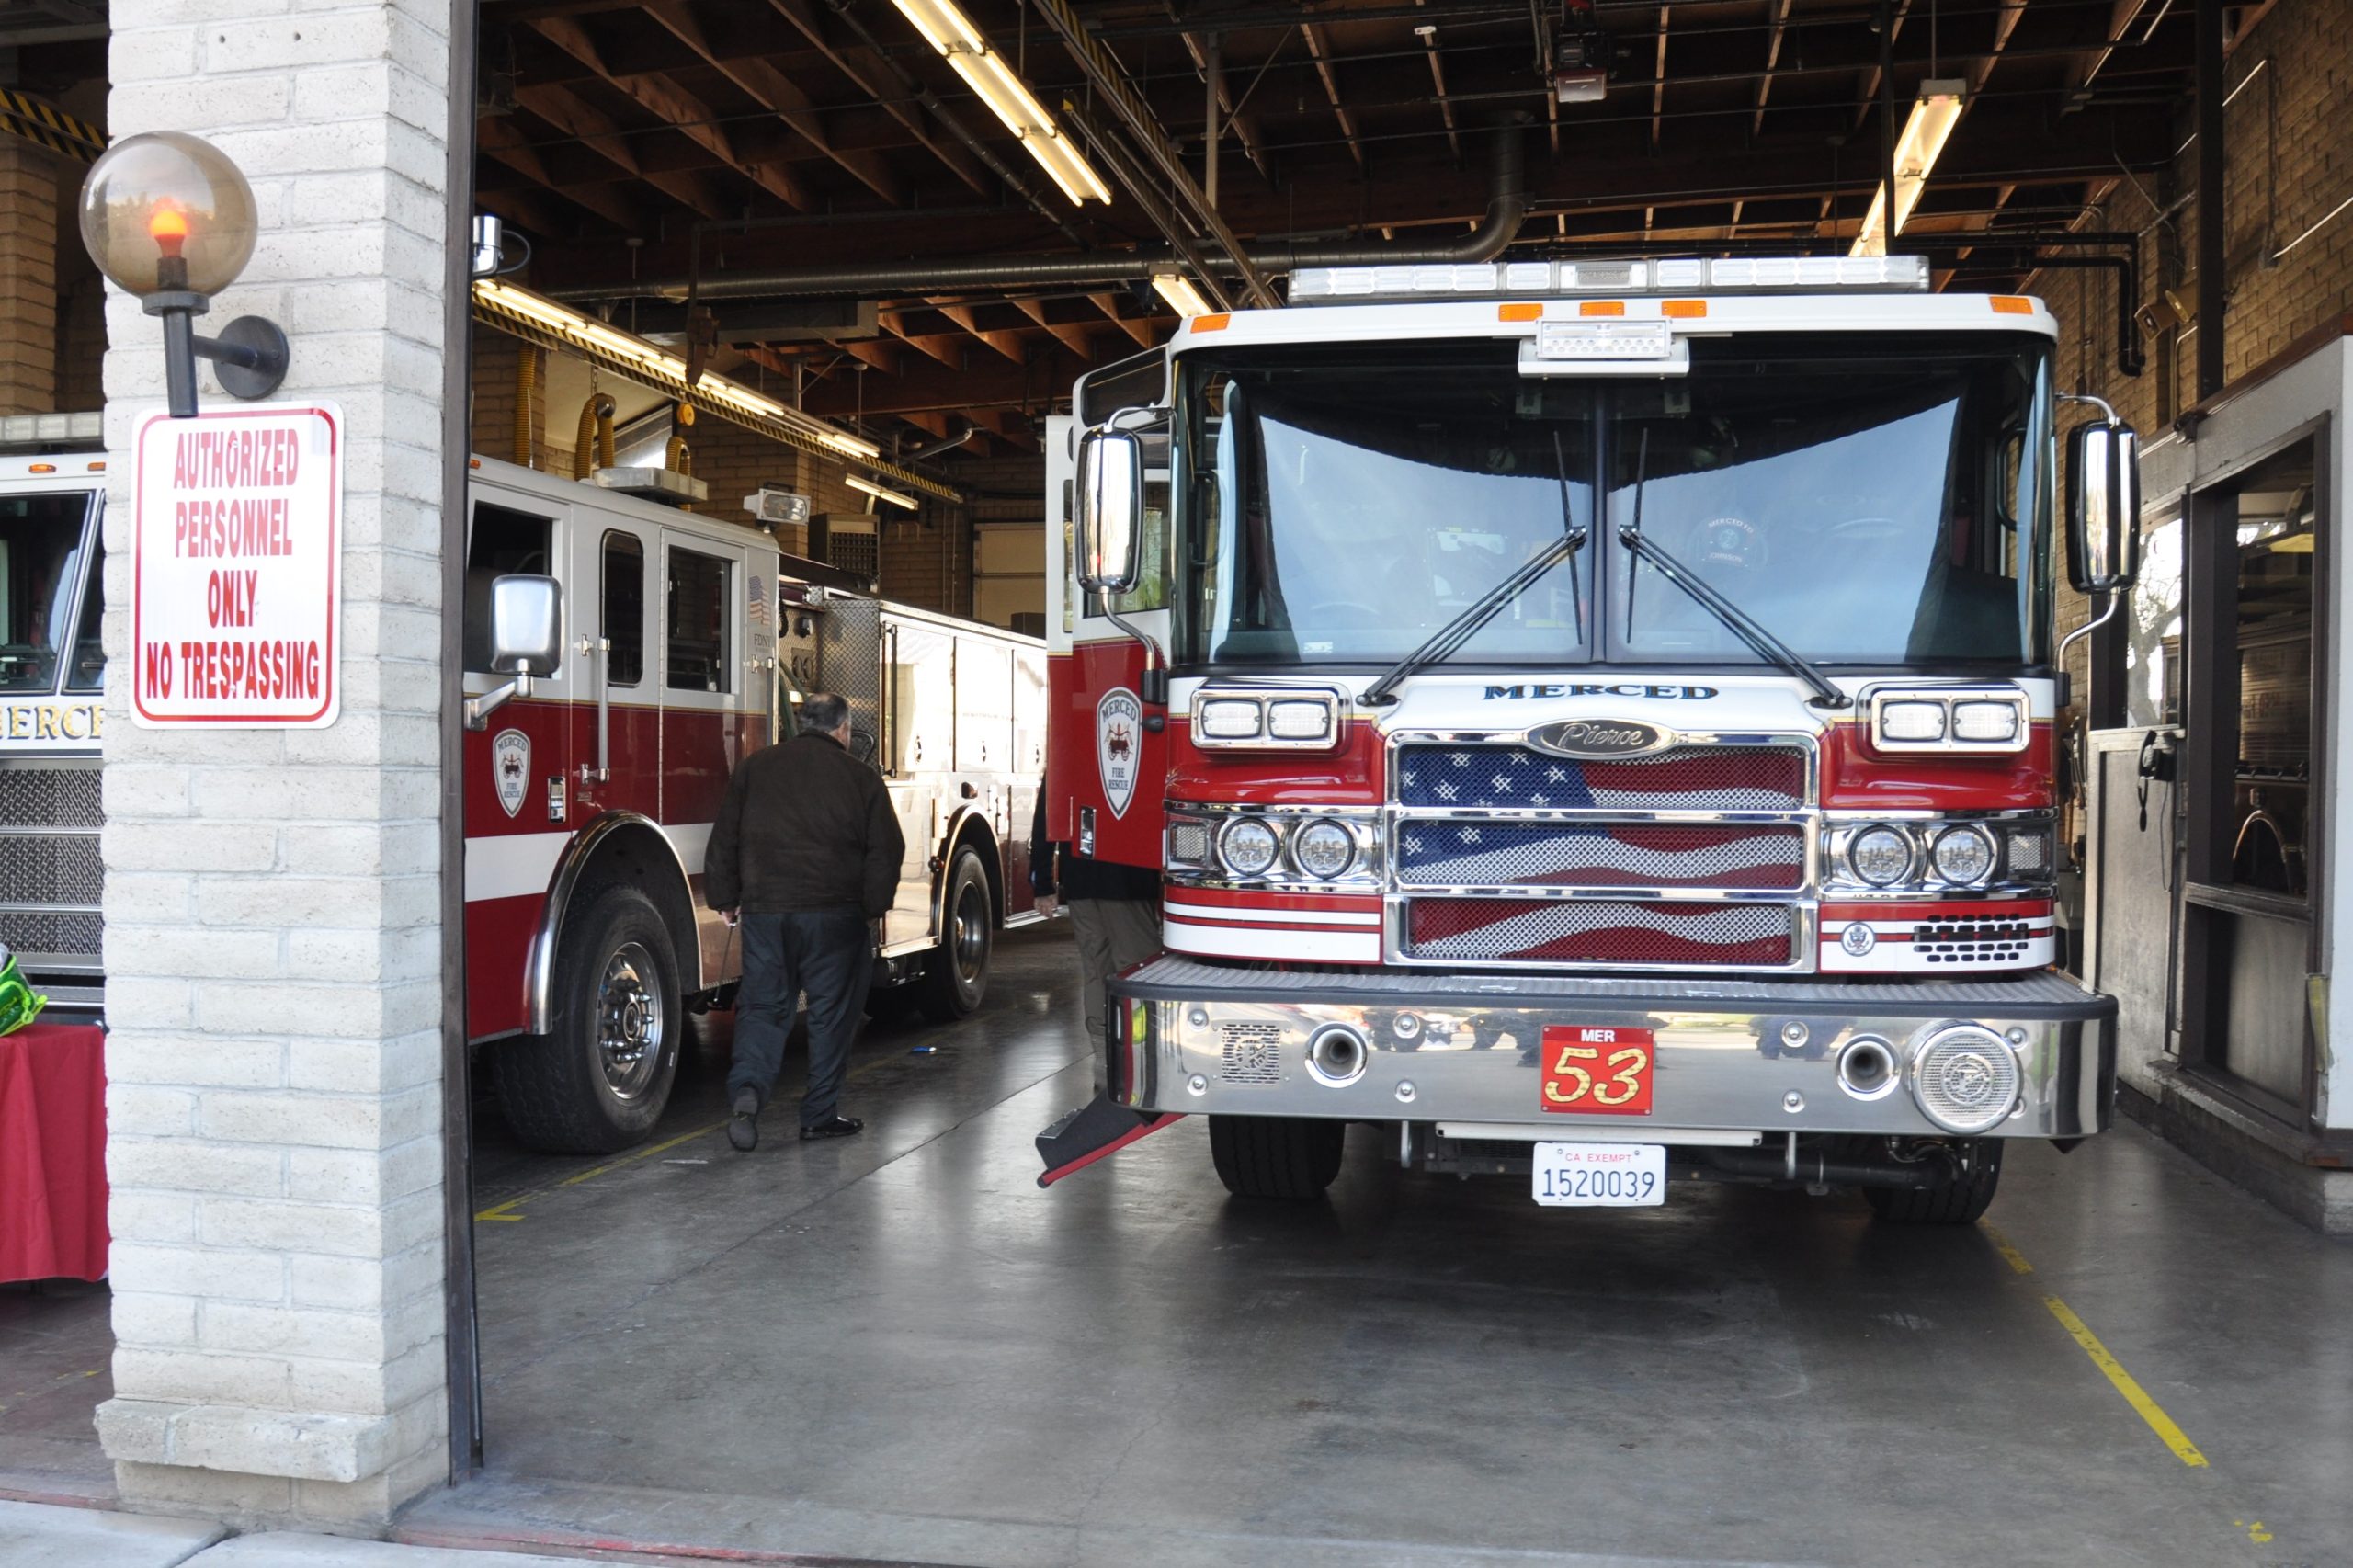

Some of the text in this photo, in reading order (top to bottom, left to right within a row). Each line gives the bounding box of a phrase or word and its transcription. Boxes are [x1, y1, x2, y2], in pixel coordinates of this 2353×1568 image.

[174, 428, 300, 490] AUTHORIZED
[175, 498, 293, 558] PERSONNEL
[208, 569, 258, 629] ONLY
[147, 640, 320, 699] NO TRESPASSING
[1483, 684, 1719, 700] MERCED
[1102, 699, 1137, 722] MERCED
[497, 736, 527, 752] MERCED
[1557, 722, 1644, 749] Pierce
[1108, 779, 1129, 790] RESCUE
[1111, 767, 1125, 778] FIRE
[1581, 1029, 1616, 1043] MER
[1544, 1046, 1648, 1105] 53
[1565, 1153, 1632, 1164] CA EXEMPT
[1542, 1168, 1655, 1199] 1520039
